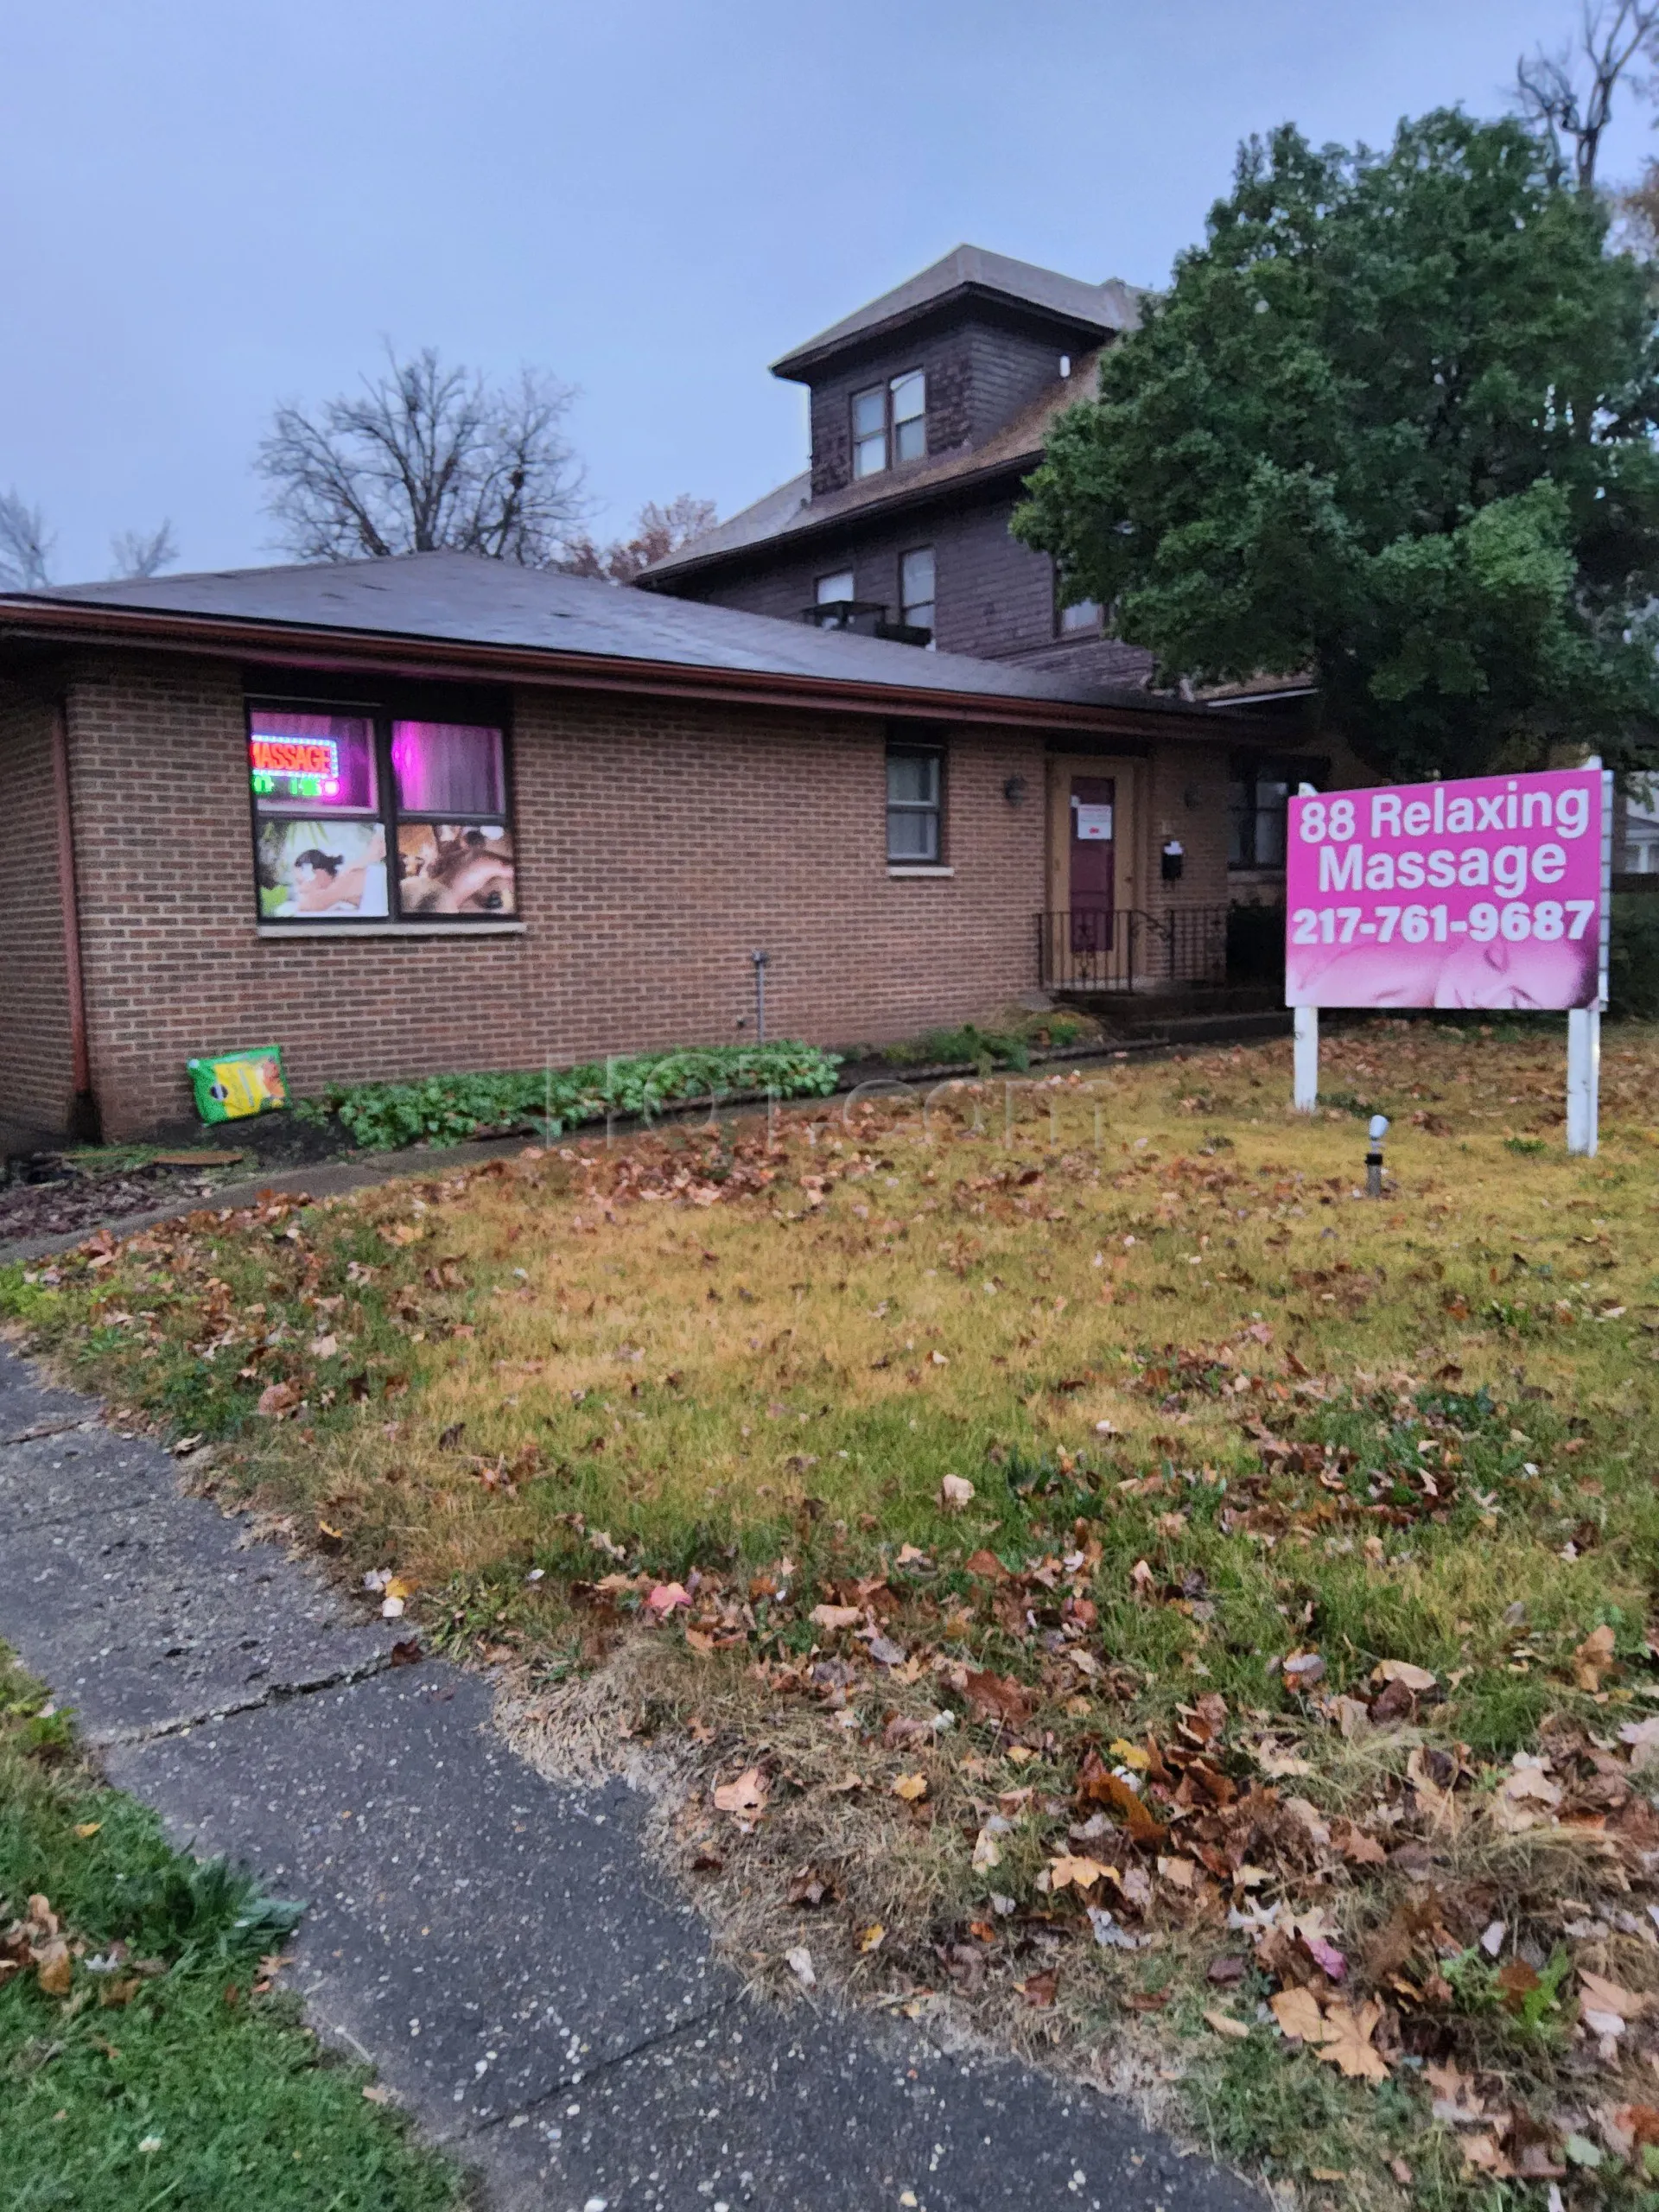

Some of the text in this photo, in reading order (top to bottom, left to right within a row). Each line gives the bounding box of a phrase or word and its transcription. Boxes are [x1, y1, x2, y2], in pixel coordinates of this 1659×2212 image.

[1300, 781, 1589, 842] 88 Relaxing
[1319, 842, 1567, 898] Massage
[1292, 899, 1595, 944] 217-761-9687
